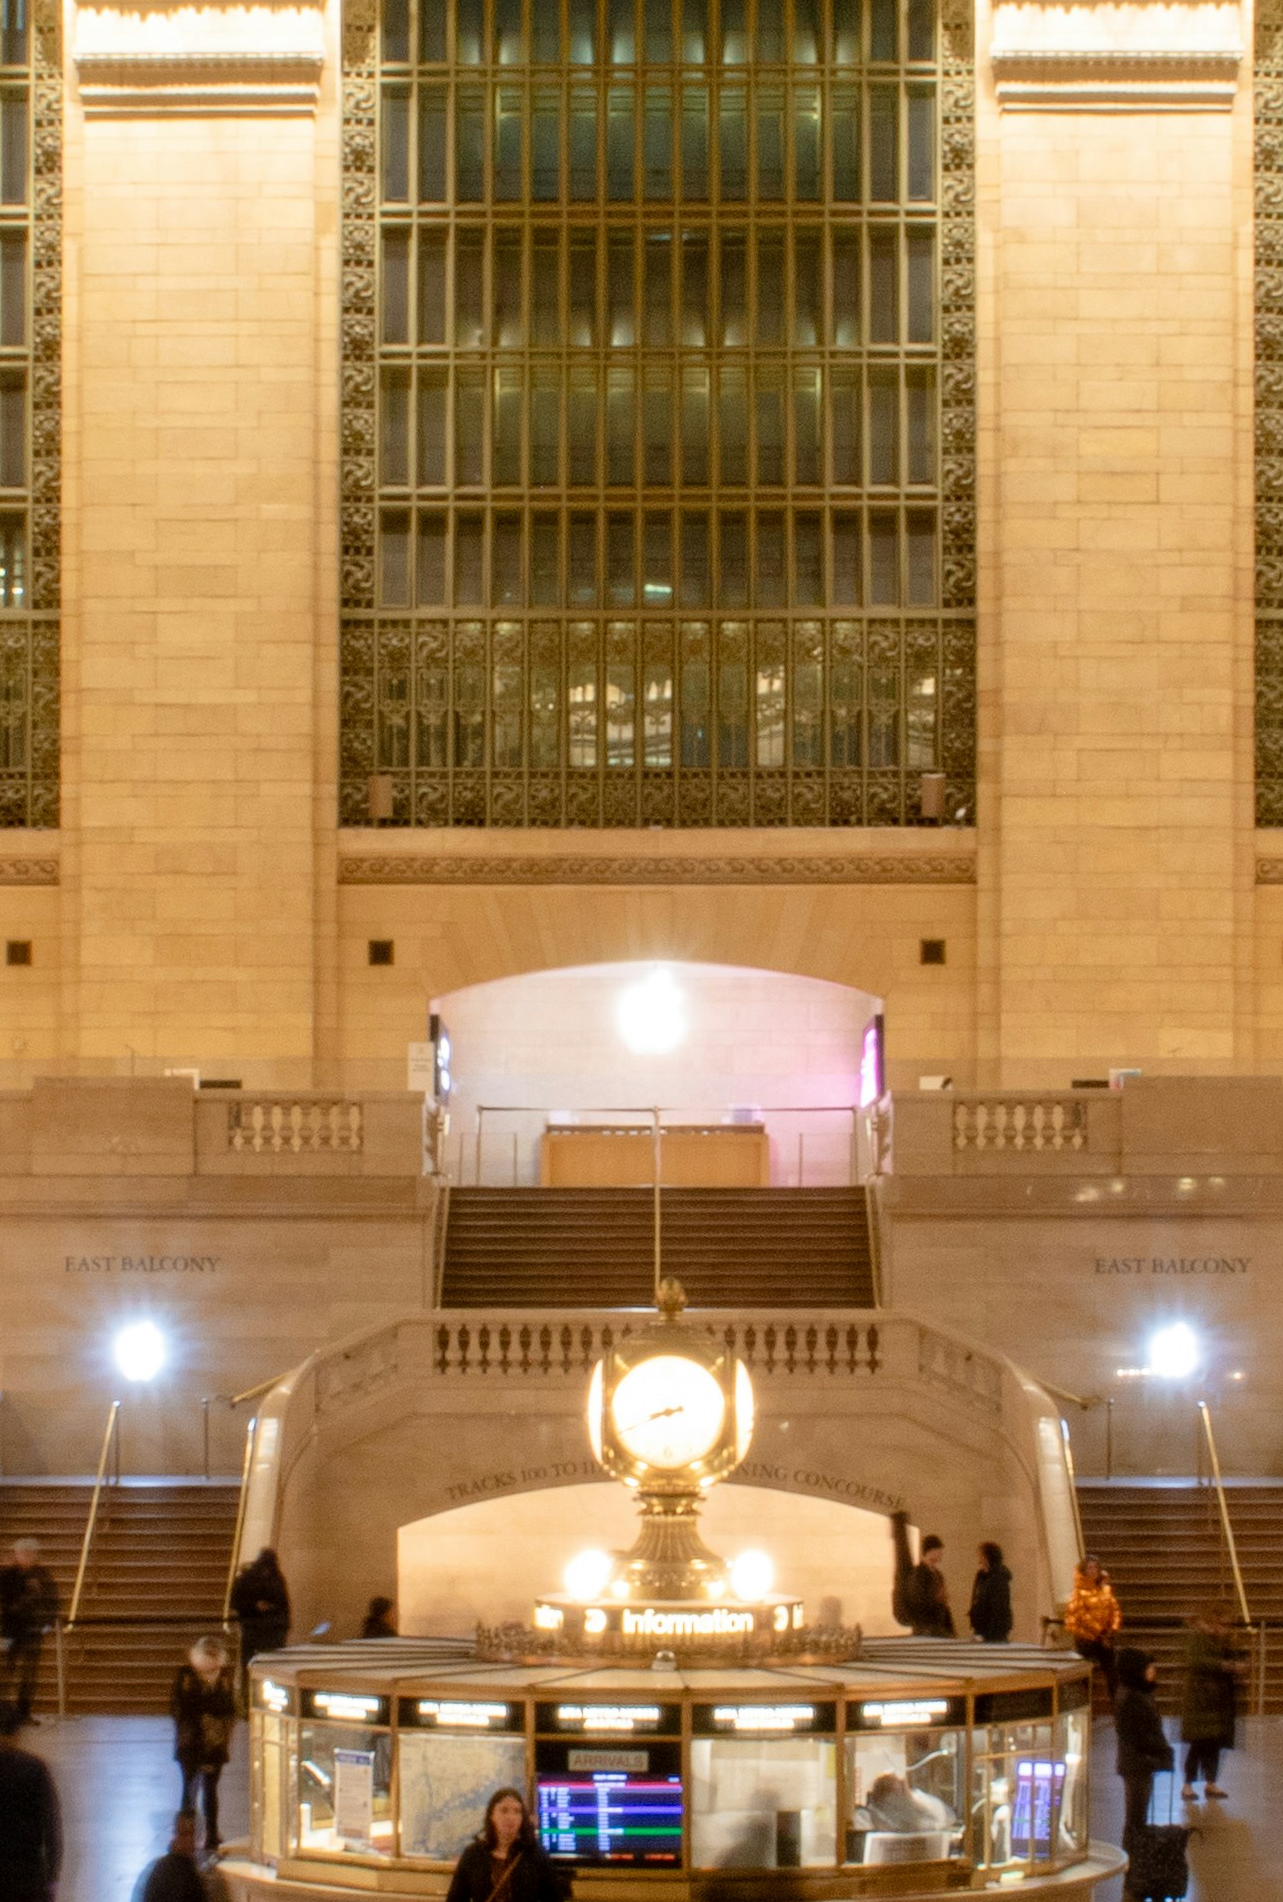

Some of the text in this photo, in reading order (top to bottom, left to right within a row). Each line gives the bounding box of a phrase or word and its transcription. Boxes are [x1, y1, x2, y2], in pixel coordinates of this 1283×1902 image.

[65, 1256, 220, 1273] EAST BALCONY
[1095, 1257, 1251, 1274] EAST BALCONY
[445, 1469, 518, 1499] TRACKS
[550, 1461, 577, 1478] TO
[793, 1467, 905, 1509] CONCOURSE
[622, 1608, 754, 1634] Information
[573, 1751, 643, 1767] ARRIVALS
